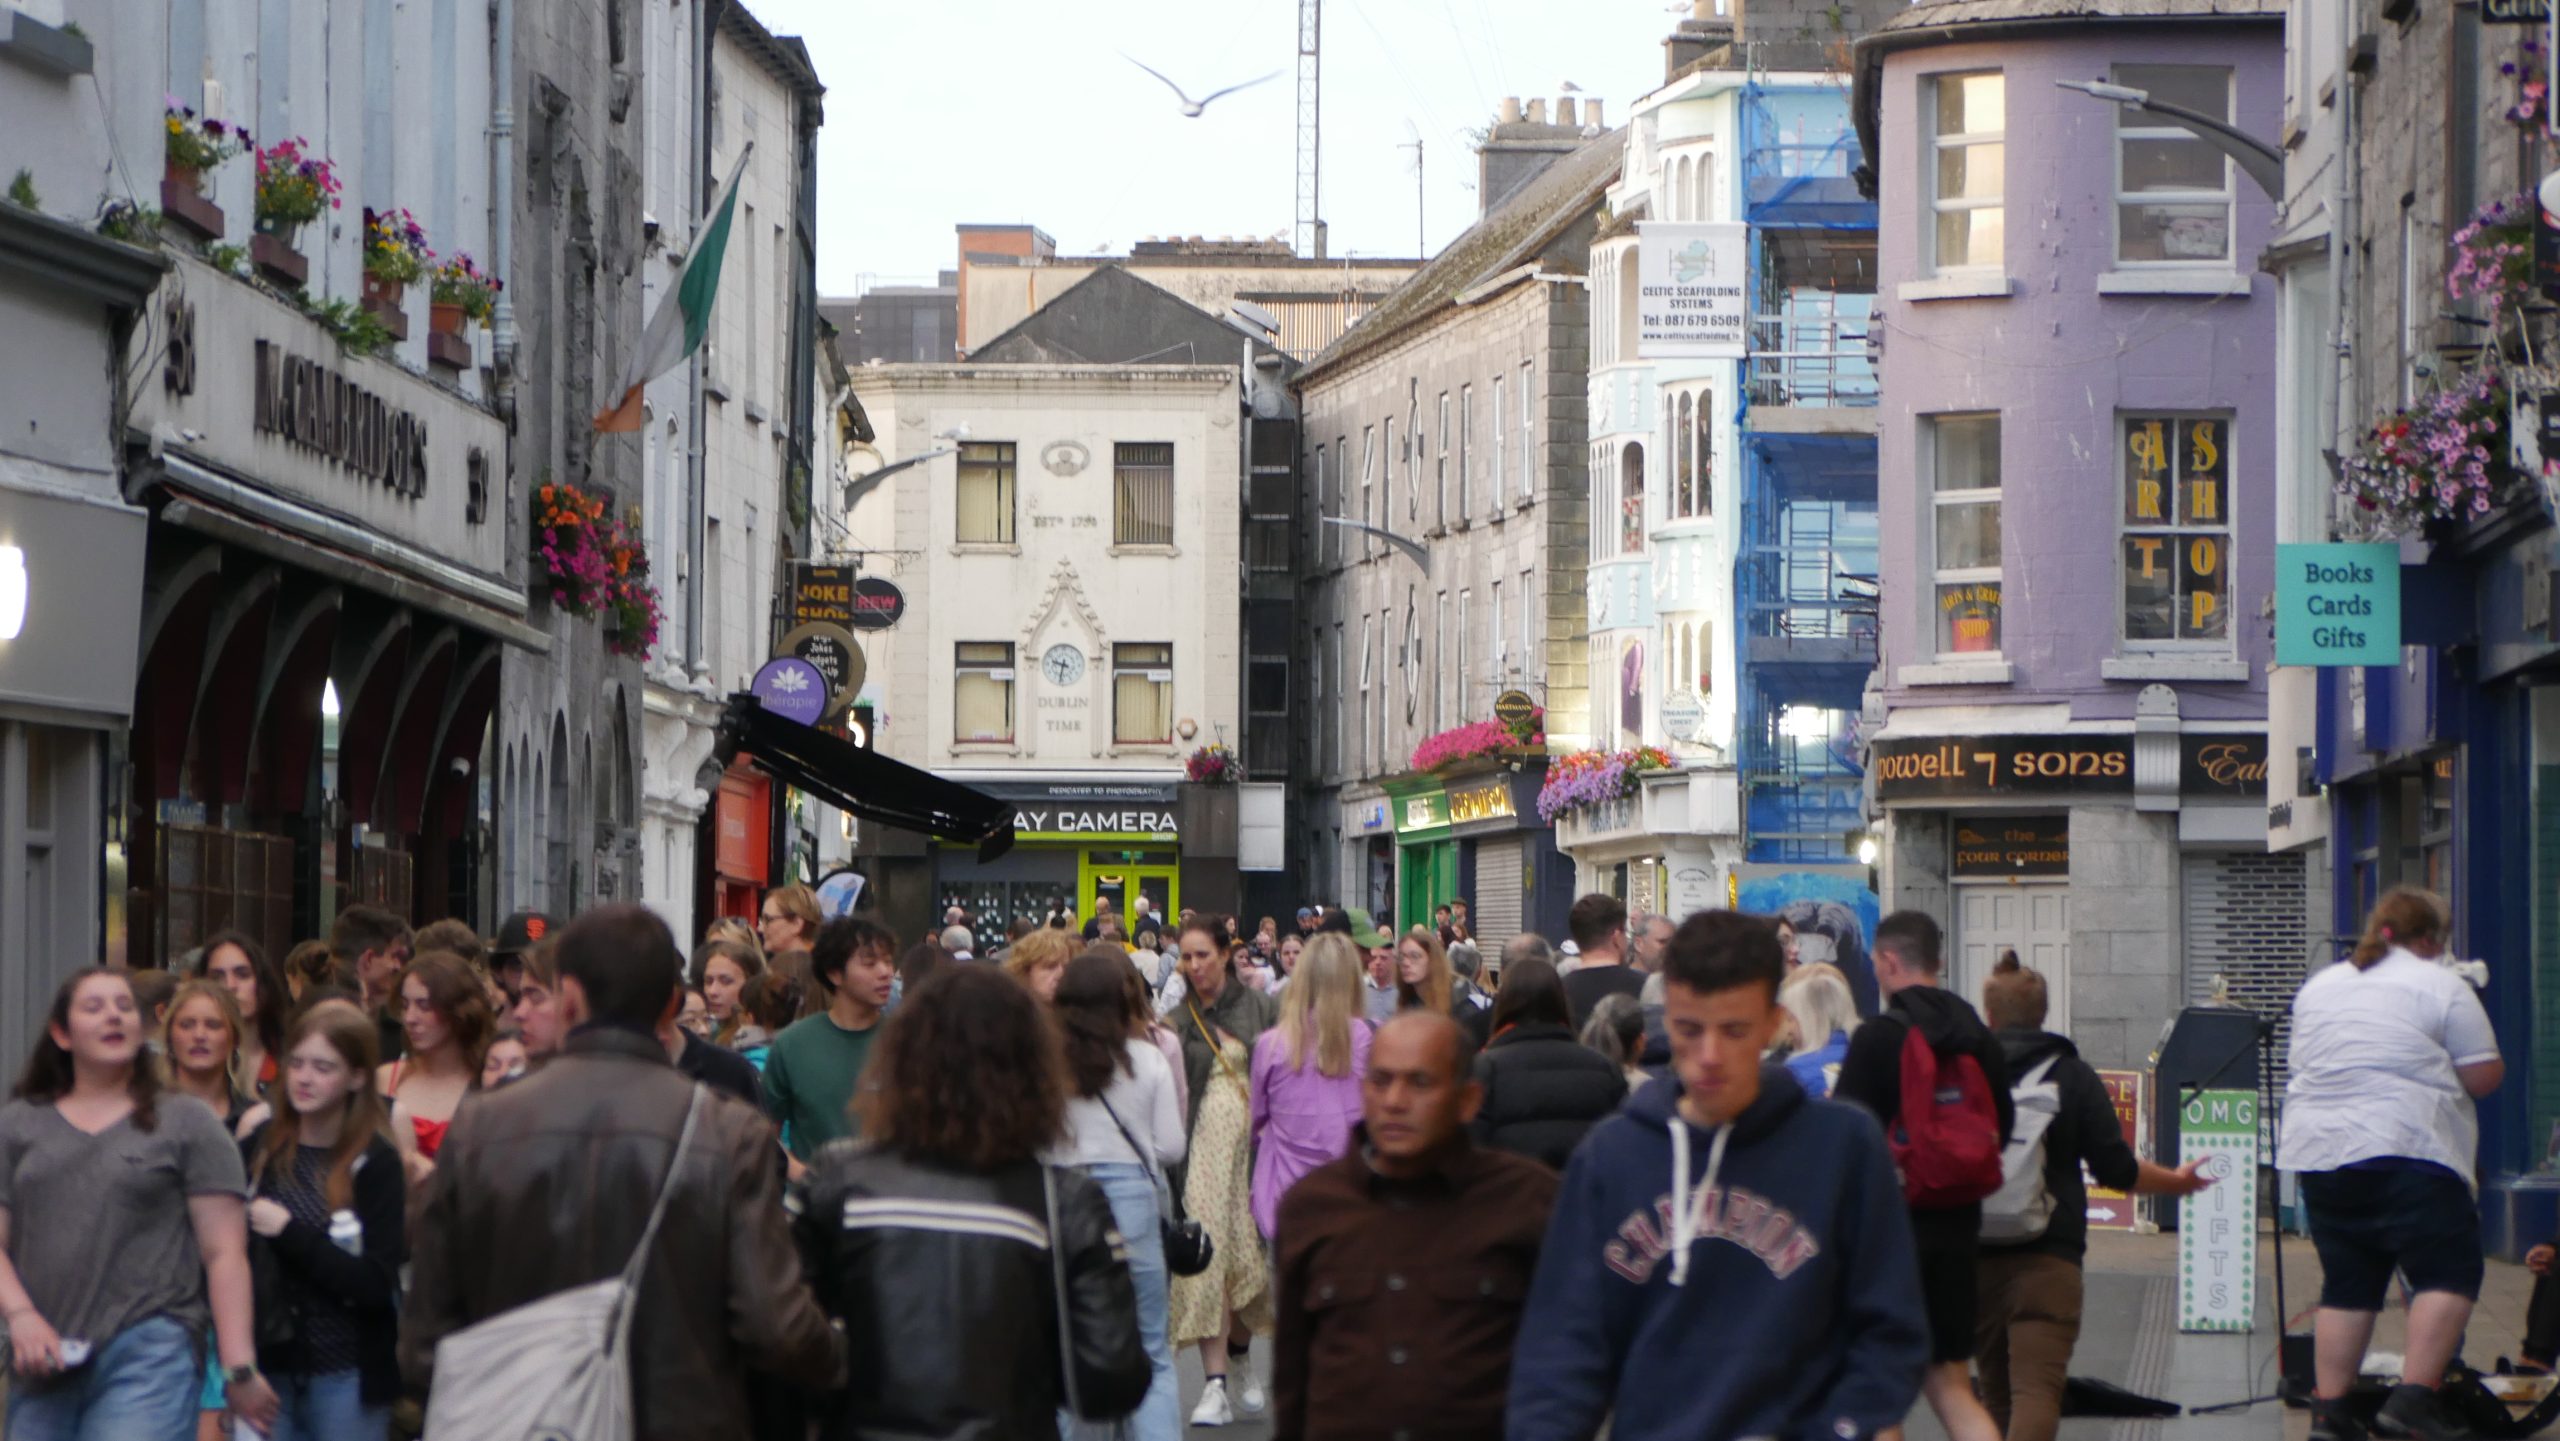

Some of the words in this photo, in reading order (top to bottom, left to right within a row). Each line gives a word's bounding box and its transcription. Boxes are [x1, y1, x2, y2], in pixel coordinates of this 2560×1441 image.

[1642, 286, 1674, 297] CELTIC
[1676, 286, 1741, 297] SCAFFOLDING
[1669, 299, 1714, 309] SYSTEMS
[1643, 314, 1663, 327] Tel:
[1665, 314, 1685, 327] 087
[1687, 314, 1708, 327] 679
[1710, 314, 1741, 327] 6509
[2129, 421, 2169, 579] ART
[2189, 420, 2219, 629] SHOP
[2304, 561, 2374, 584] Books
[798, 584, 849, 602] JOKE
[2306, 594, 2372, 616] Cards
[2312, 625, 2367, 648] Gifts
[1037, 697, 1089, 709] DUBLIN
[1045, 720, 1082, 732] TIME
[1057, 811, 1178, 832] CAMERA
[2186, 1100, 2253, 1125] OMG
[2207, 1152, 2233, 1310] GIFTS
